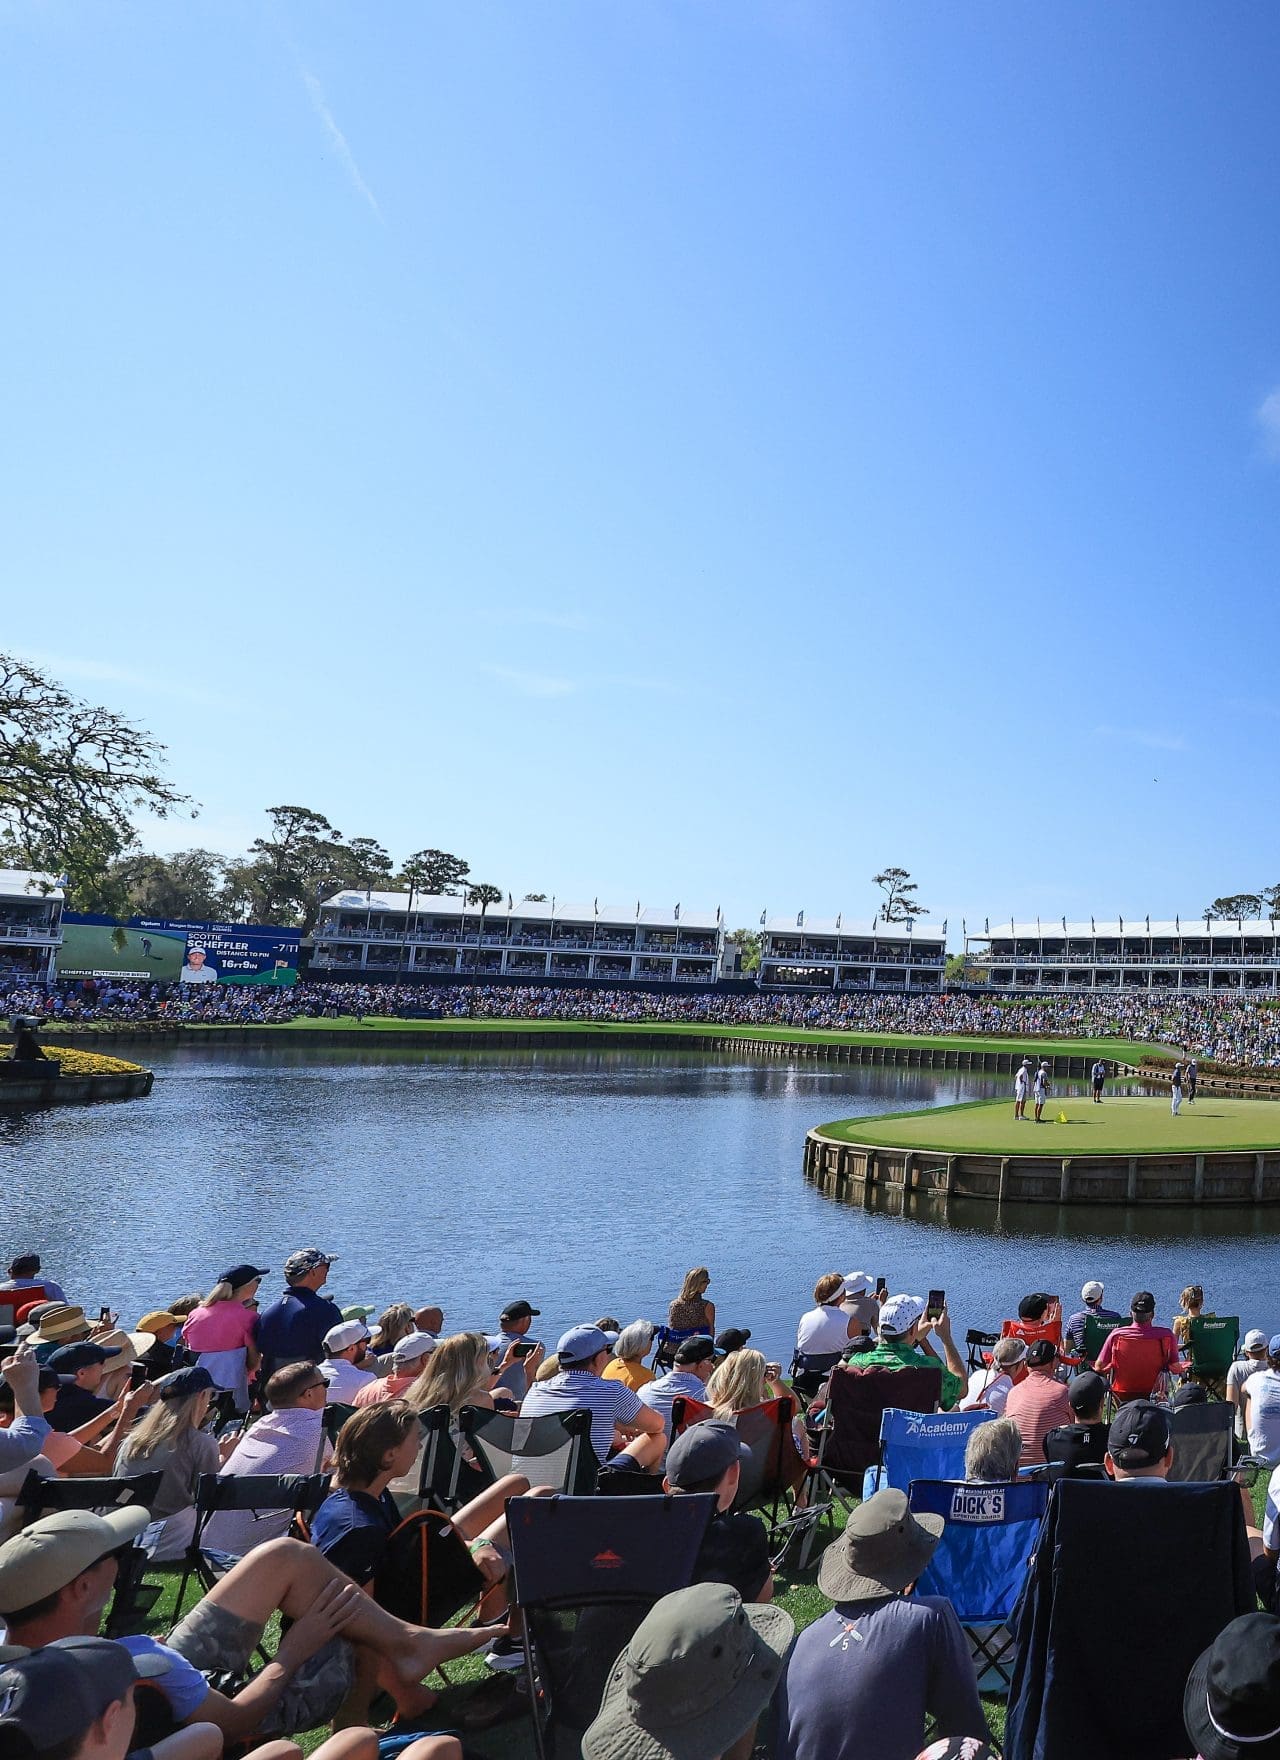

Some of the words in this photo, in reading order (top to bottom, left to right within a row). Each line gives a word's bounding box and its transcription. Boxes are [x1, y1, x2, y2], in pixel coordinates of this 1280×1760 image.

[188, 933, 222, 941] SCOTTIE
[187, 940, 249, 951] SCHEFFLER
[920, 1421, 969, 1433] Academy
[953, 1495, 1002, 1514] DICK'S
[841, 1638, 850, 1651] 5
